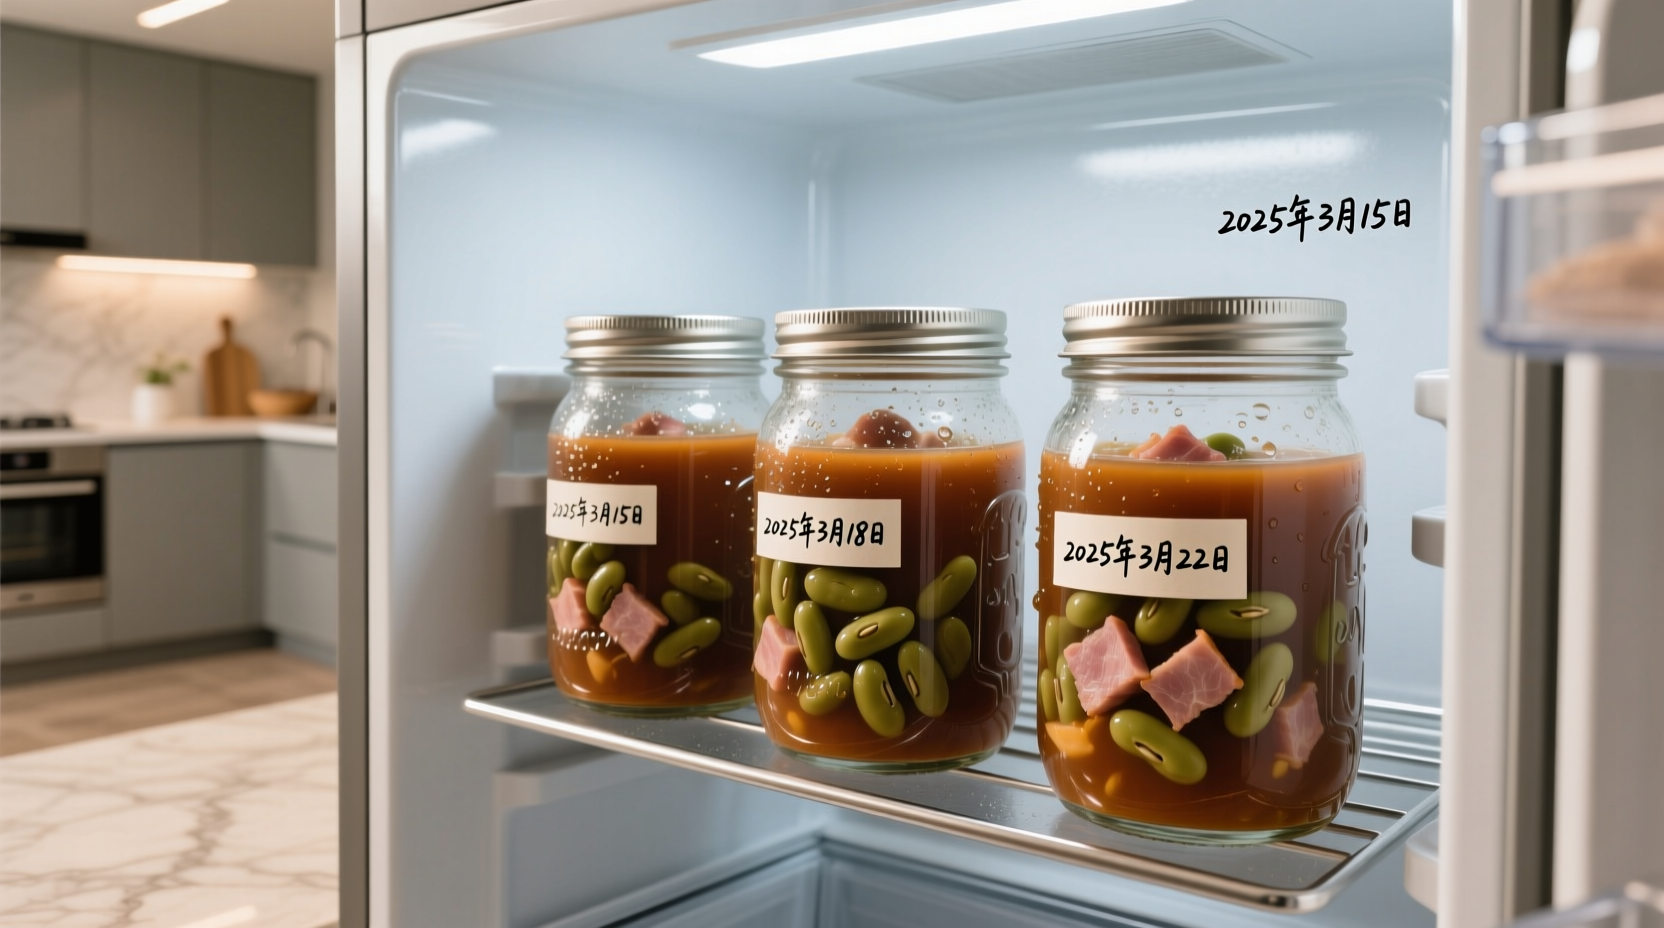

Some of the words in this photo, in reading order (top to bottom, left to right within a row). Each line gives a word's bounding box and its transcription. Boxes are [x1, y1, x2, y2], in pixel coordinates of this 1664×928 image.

[552, 497, 643, 527] 2025年3月15日
[764, 511, 884, 549] 2025年3月18日
[1063, 534, 1229, 578] 2025年3月22日
